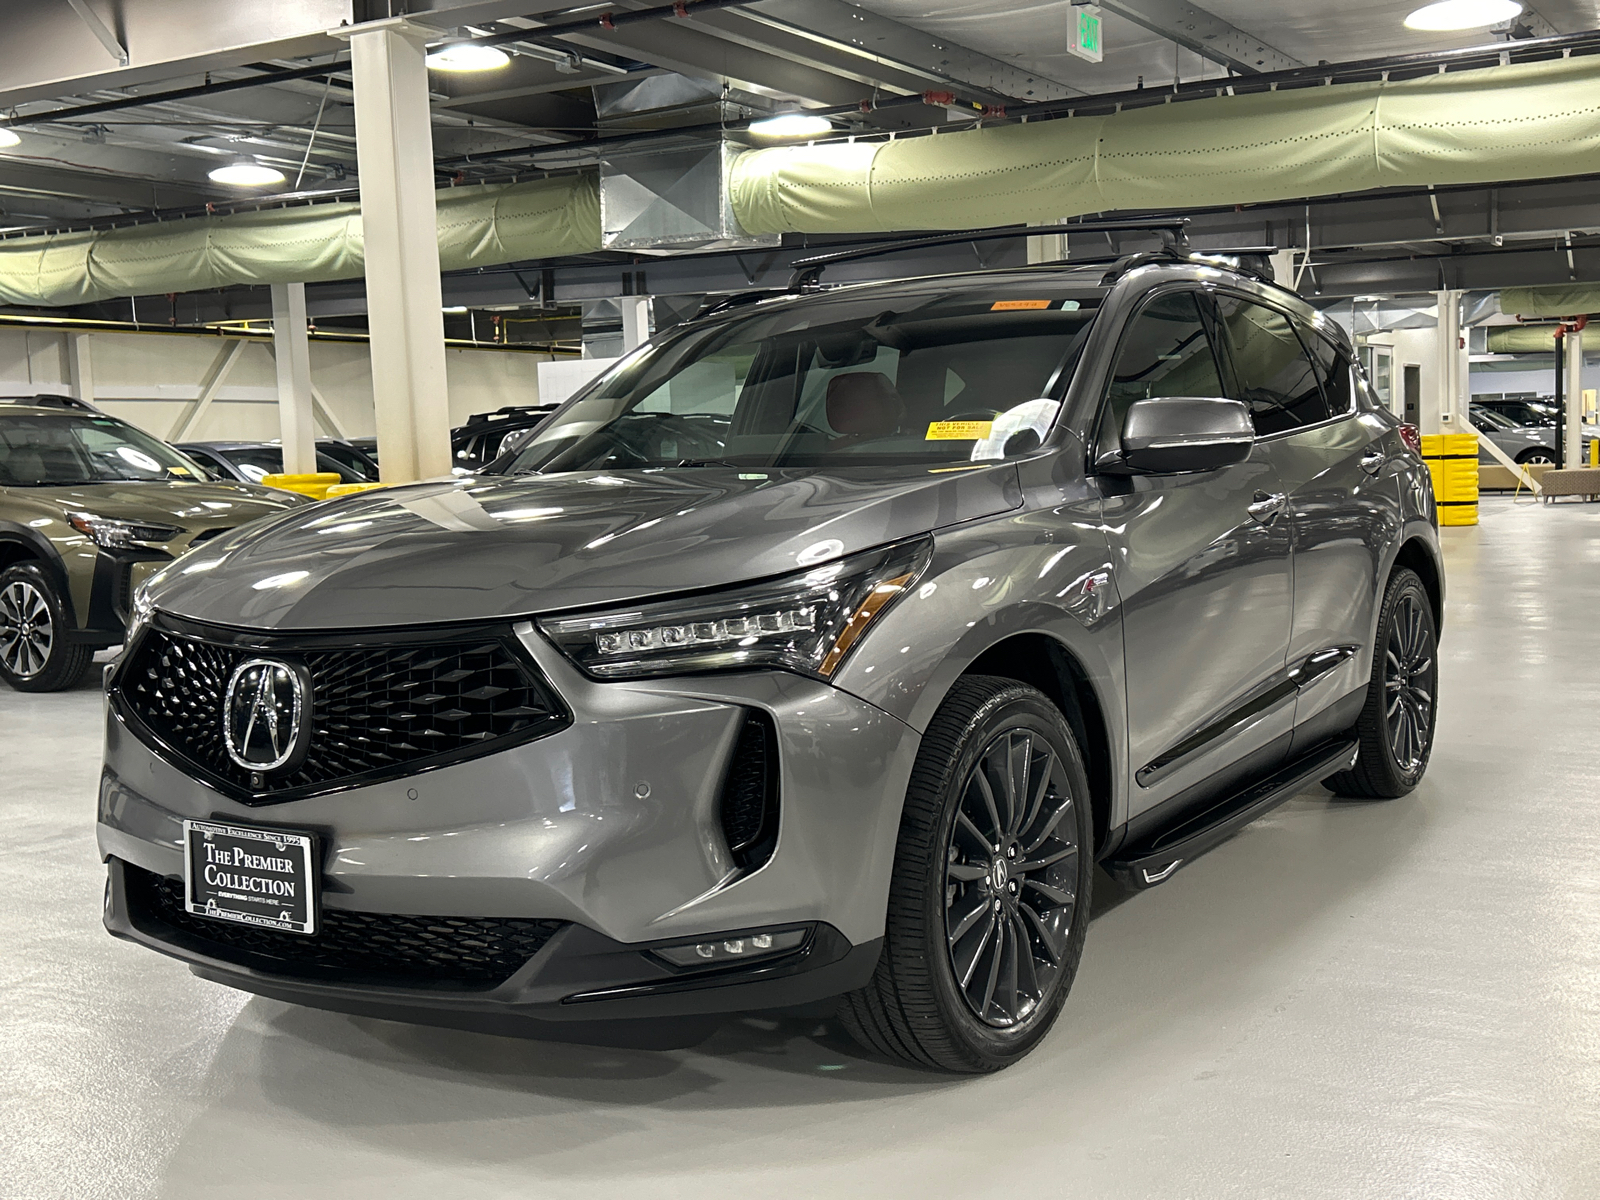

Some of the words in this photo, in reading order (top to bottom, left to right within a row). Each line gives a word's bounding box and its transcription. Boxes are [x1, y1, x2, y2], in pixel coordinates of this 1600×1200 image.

[1081, 12, 1098, 53] EXIT
[192, 822, 227, 834] AUTOMOTIVE
[227, 828, 262, 839] EXCELLENCE
[263, 833, 282, 842] SINCE
[283, 835, 301, 845] 1995
[203, 842, 232, 866] THE
[233, 847, 295, 874] PREMIER
[204, 864, 296, 898] COLLECTION
[217, 891, 248, 901] EVERYTHING
[247, 895, 266, 904] STARTS
[204, 906, 293, 929] THEPREMIERCOLLECTION.COM
